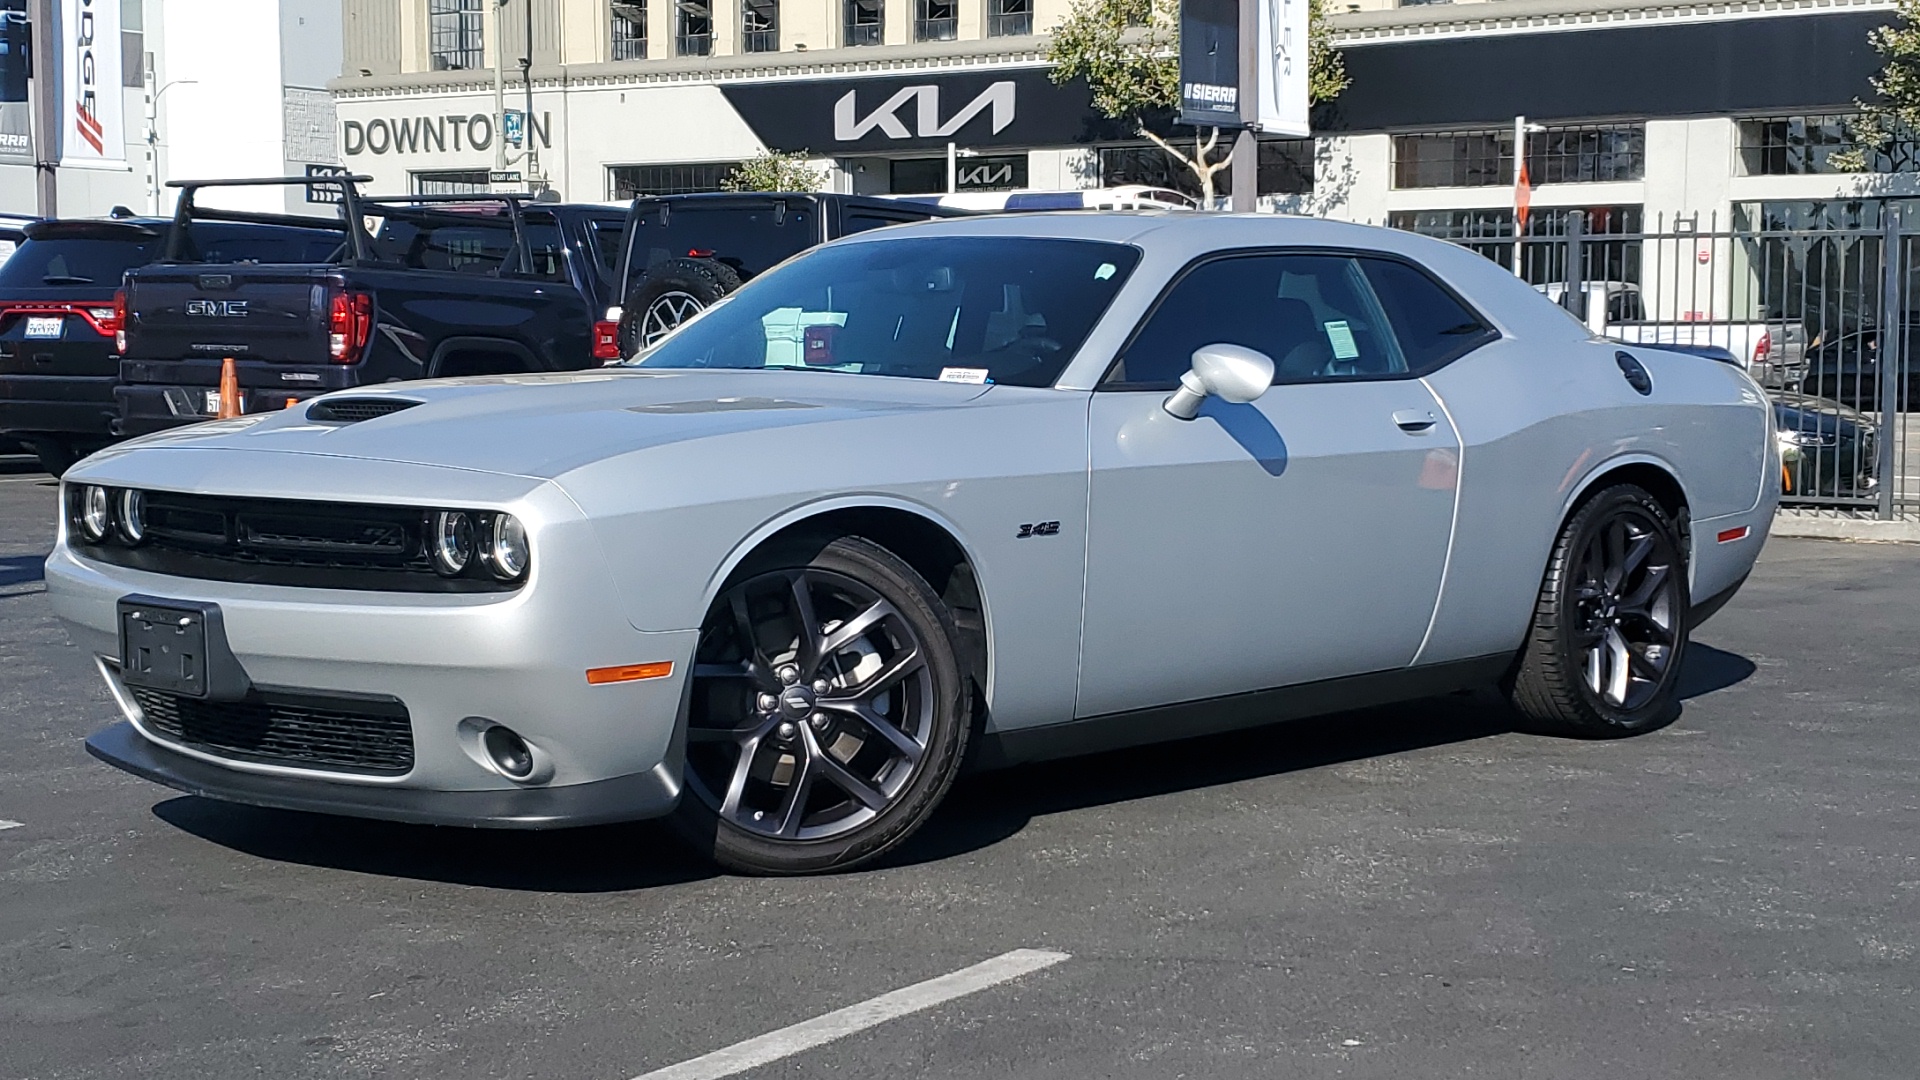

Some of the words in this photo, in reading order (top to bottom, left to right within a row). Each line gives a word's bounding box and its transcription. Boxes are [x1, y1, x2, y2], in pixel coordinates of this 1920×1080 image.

[82, 0, 96, 122] DGE
[1192, 83, 1237, 103] SIERRA
[834, 81, 1016, 141] KIA
[958, 164, 1012, 185] KIA
[185, 300, 248, 317] GMC
